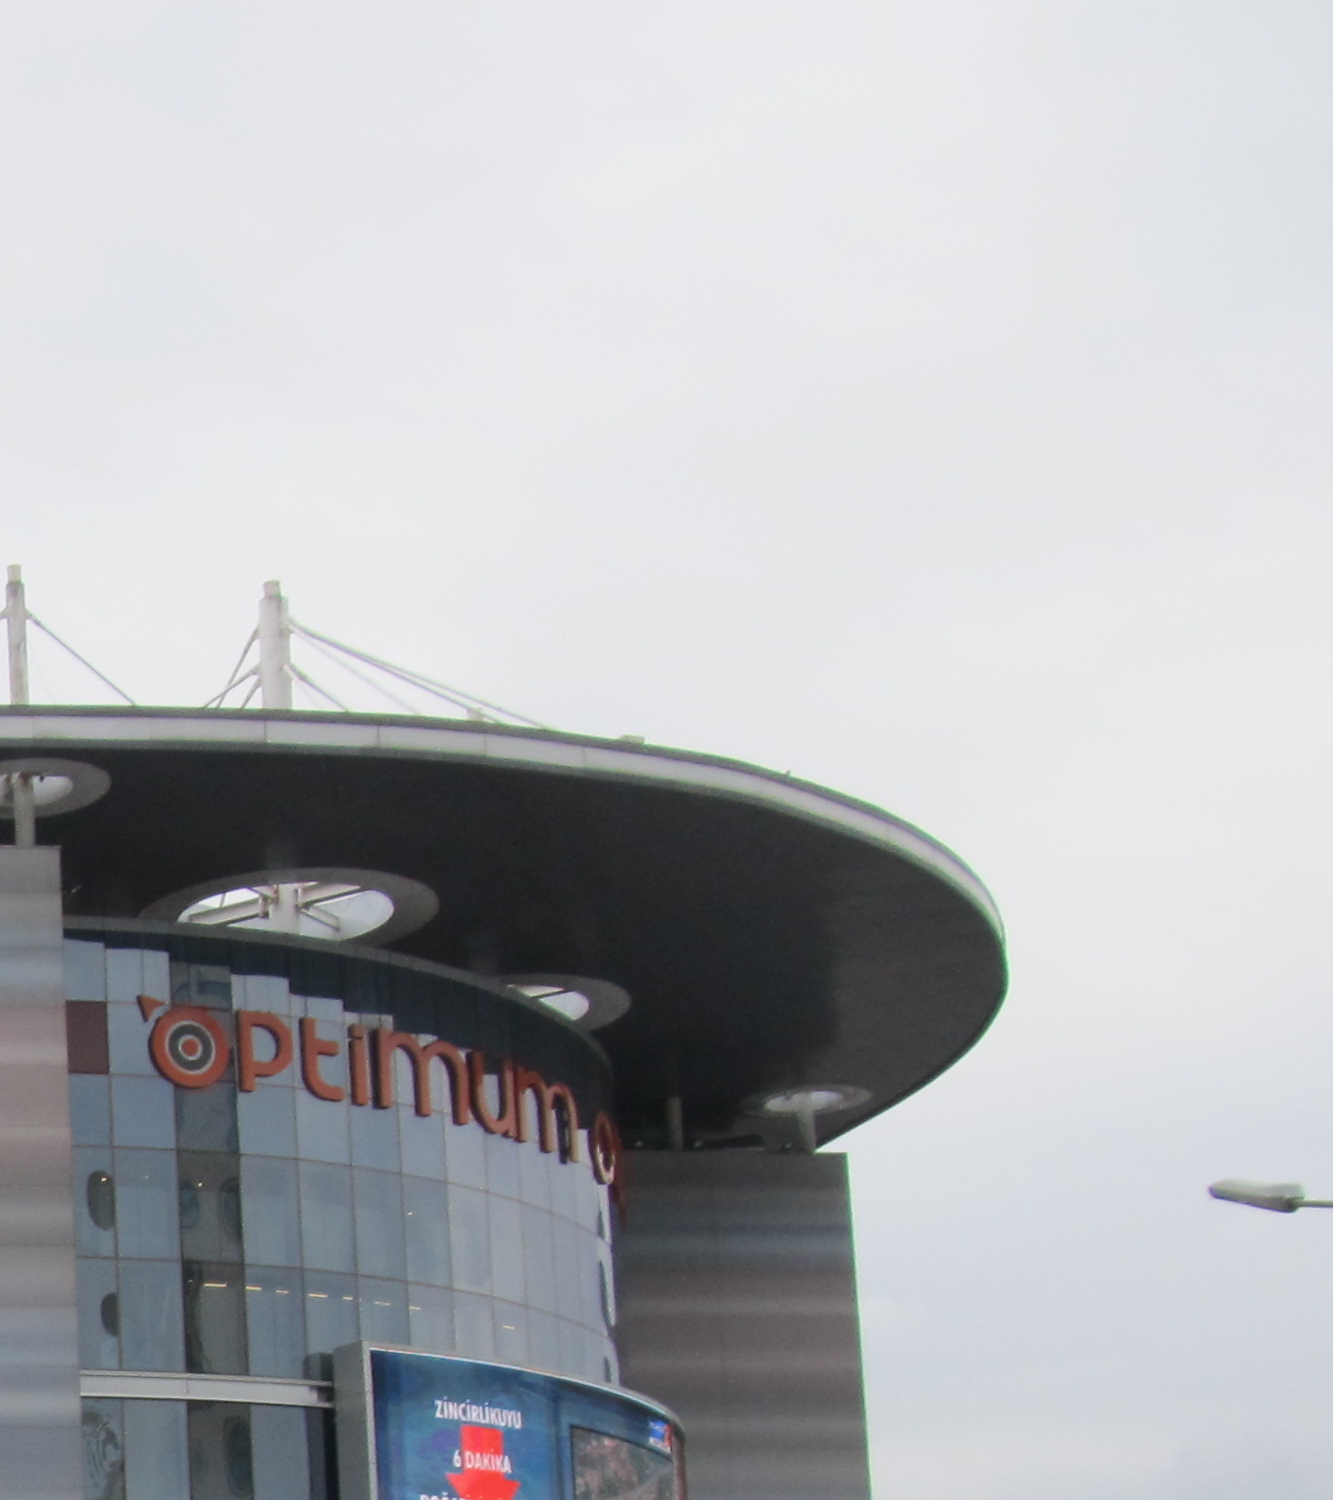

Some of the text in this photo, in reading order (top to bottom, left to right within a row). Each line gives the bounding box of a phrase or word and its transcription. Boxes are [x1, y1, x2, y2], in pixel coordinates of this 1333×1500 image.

[434, 1396, 523, 1430] ZİNCİRLİKUYU
[453, 1449, 513, 1474] 6 DAKİKA
